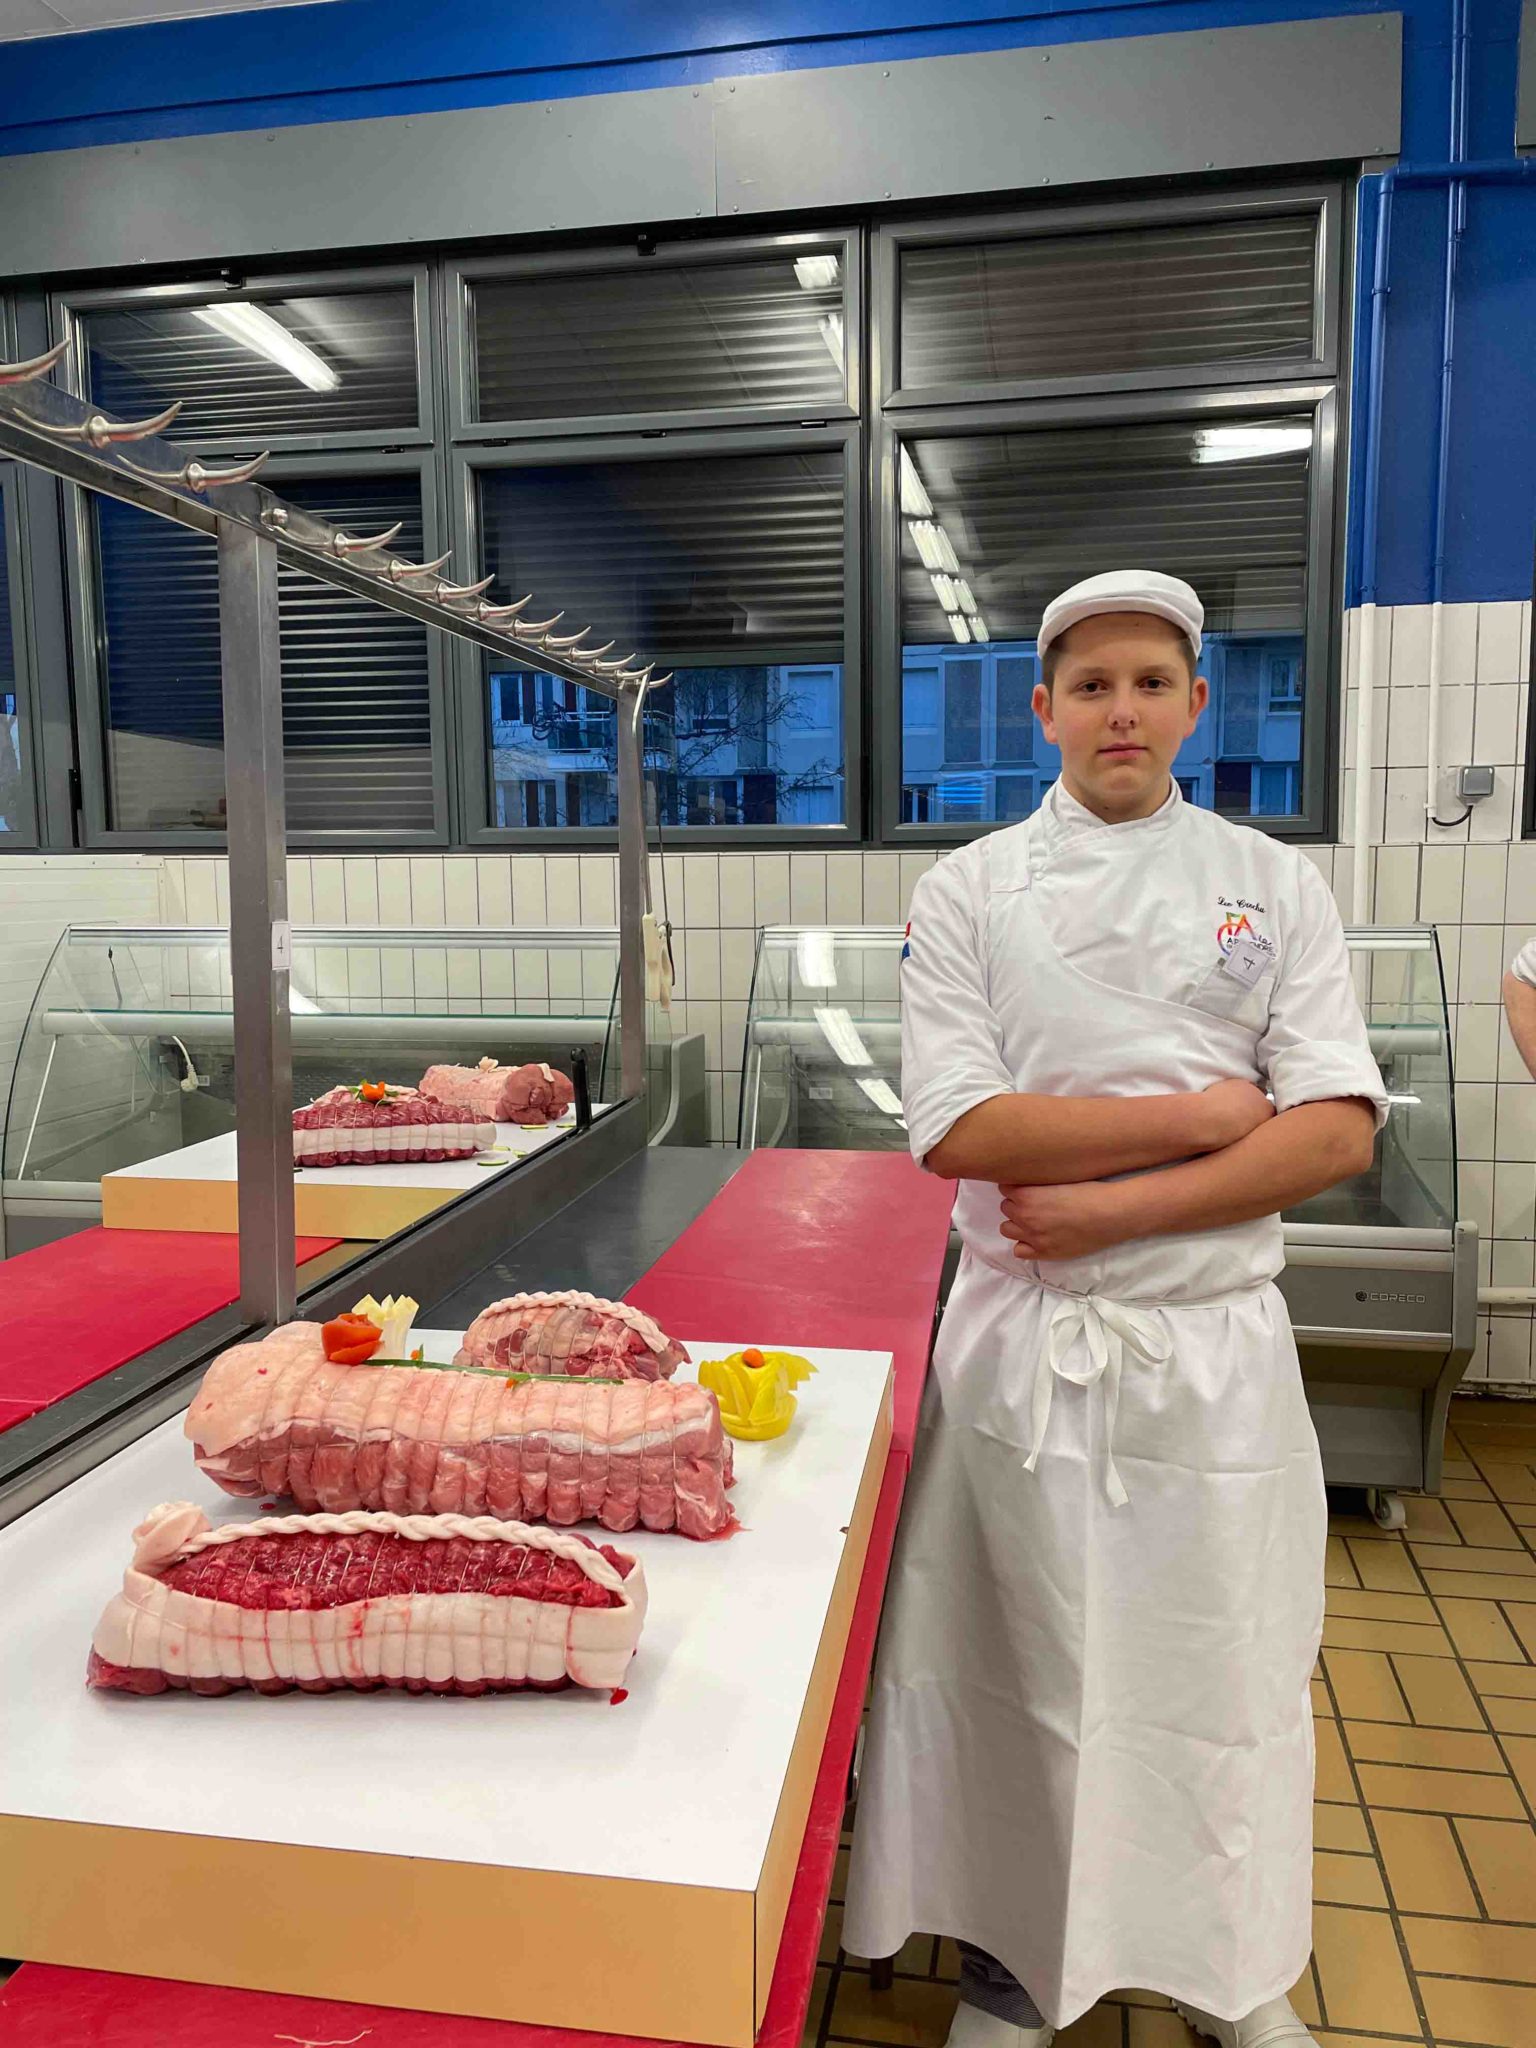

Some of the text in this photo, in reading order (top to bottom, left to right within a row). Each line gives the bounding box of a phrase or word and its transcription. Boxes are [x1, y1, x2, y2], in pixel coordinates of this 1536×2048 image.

[277, 936, 284, 955] 4
[1243, 956, 1256, 970] 4
[1370, 1292, 1425, 1303] CORECO
